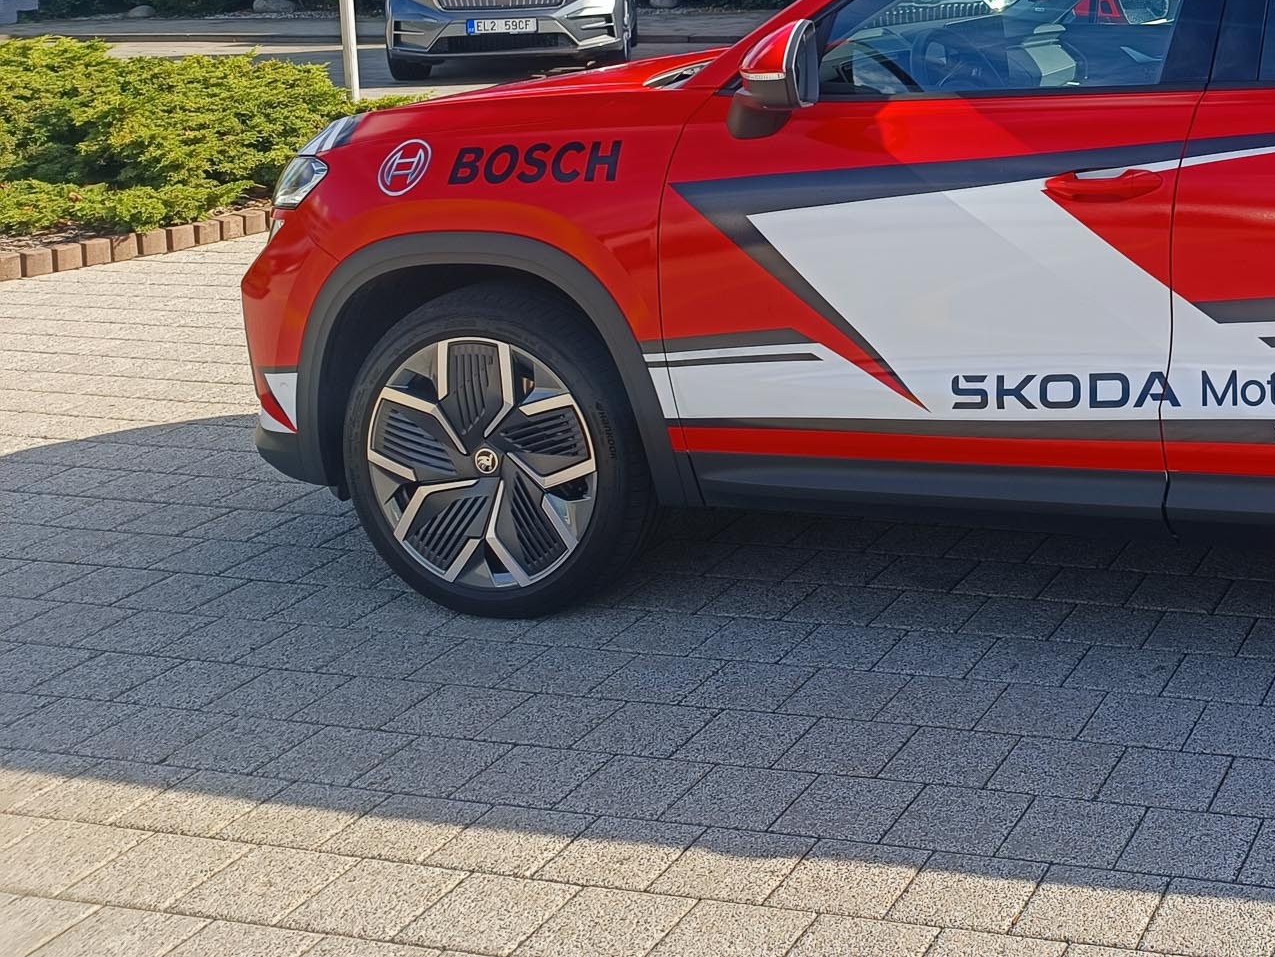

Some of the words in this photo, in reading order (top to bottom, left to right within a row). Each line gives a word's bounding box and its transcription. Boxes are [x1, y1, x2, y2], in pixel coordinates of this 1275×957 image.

[476, 20, 497, 32] EL2
[504, 19, 531, 31] 59CF
[447, 139, 623, 186] BOSCH
